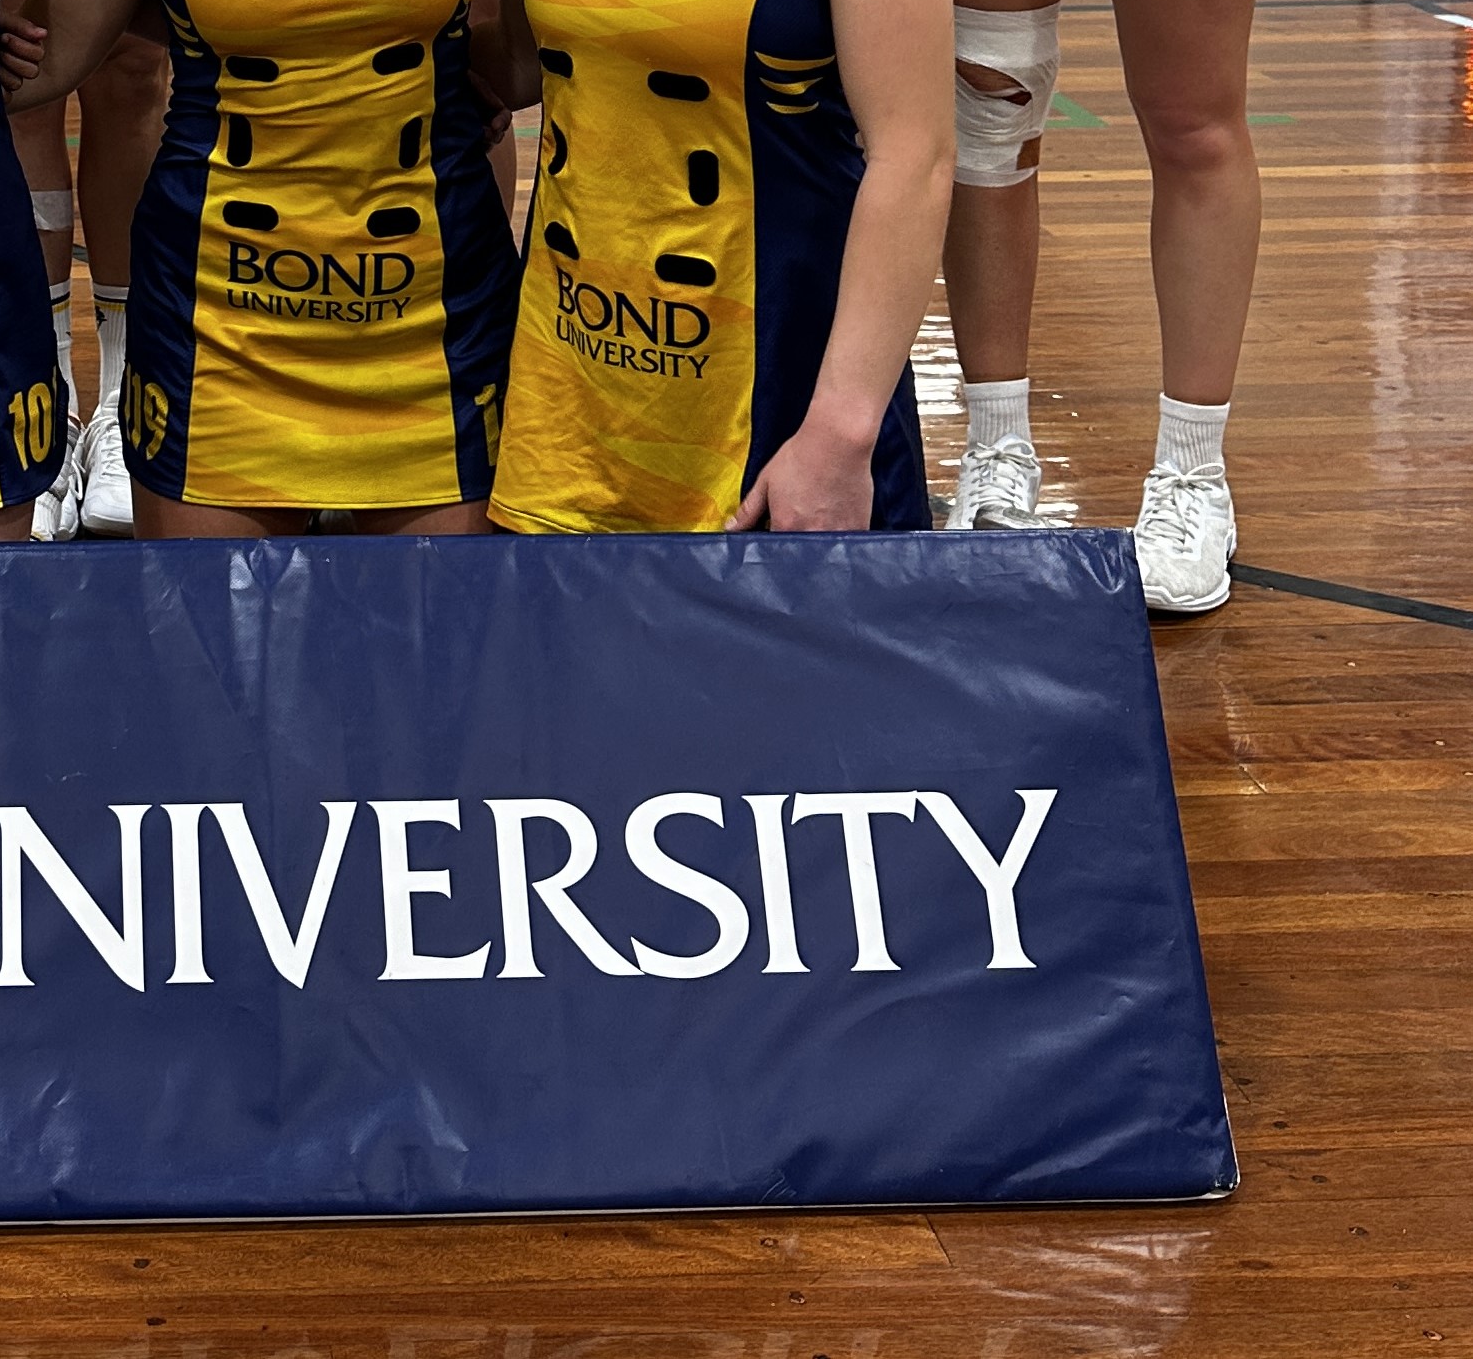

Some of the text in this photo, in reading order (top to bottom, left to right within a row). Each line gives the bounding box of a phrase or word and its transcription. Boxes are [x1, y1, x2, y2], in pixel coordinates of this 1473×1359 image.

[227, 240, 415, 298] BOND
[226, 288, 411, 323] UNIVERSITY
[556, 265, 711, 349] BOND
[556, 314, 711, 379] UNIVERSITY
